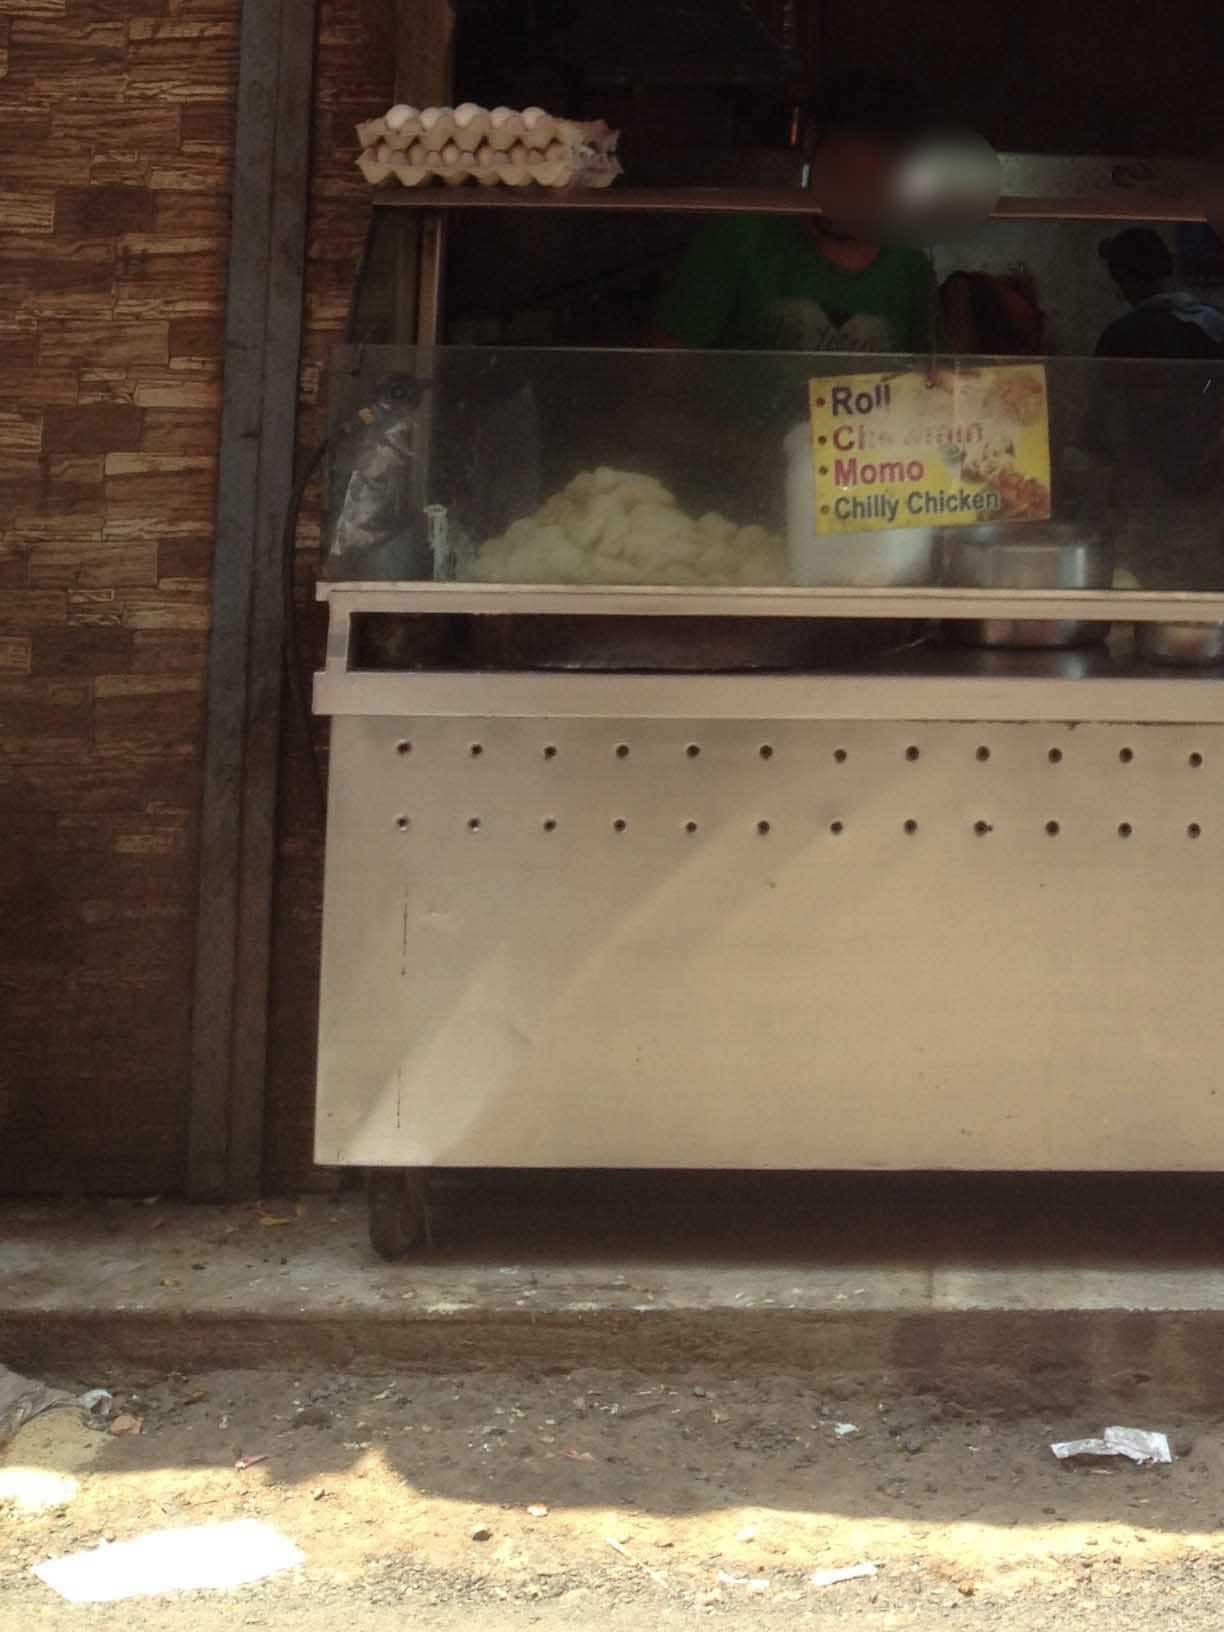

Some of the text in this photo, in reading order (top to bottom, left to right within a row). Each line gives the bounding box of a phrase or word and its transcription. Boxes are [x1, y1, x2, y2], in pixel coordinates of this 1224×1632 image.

[831, 384, 891, 416] Roll
[834, 459, 925, 486] Momo
[833, 490, 998, 522] Chilly Chicken
